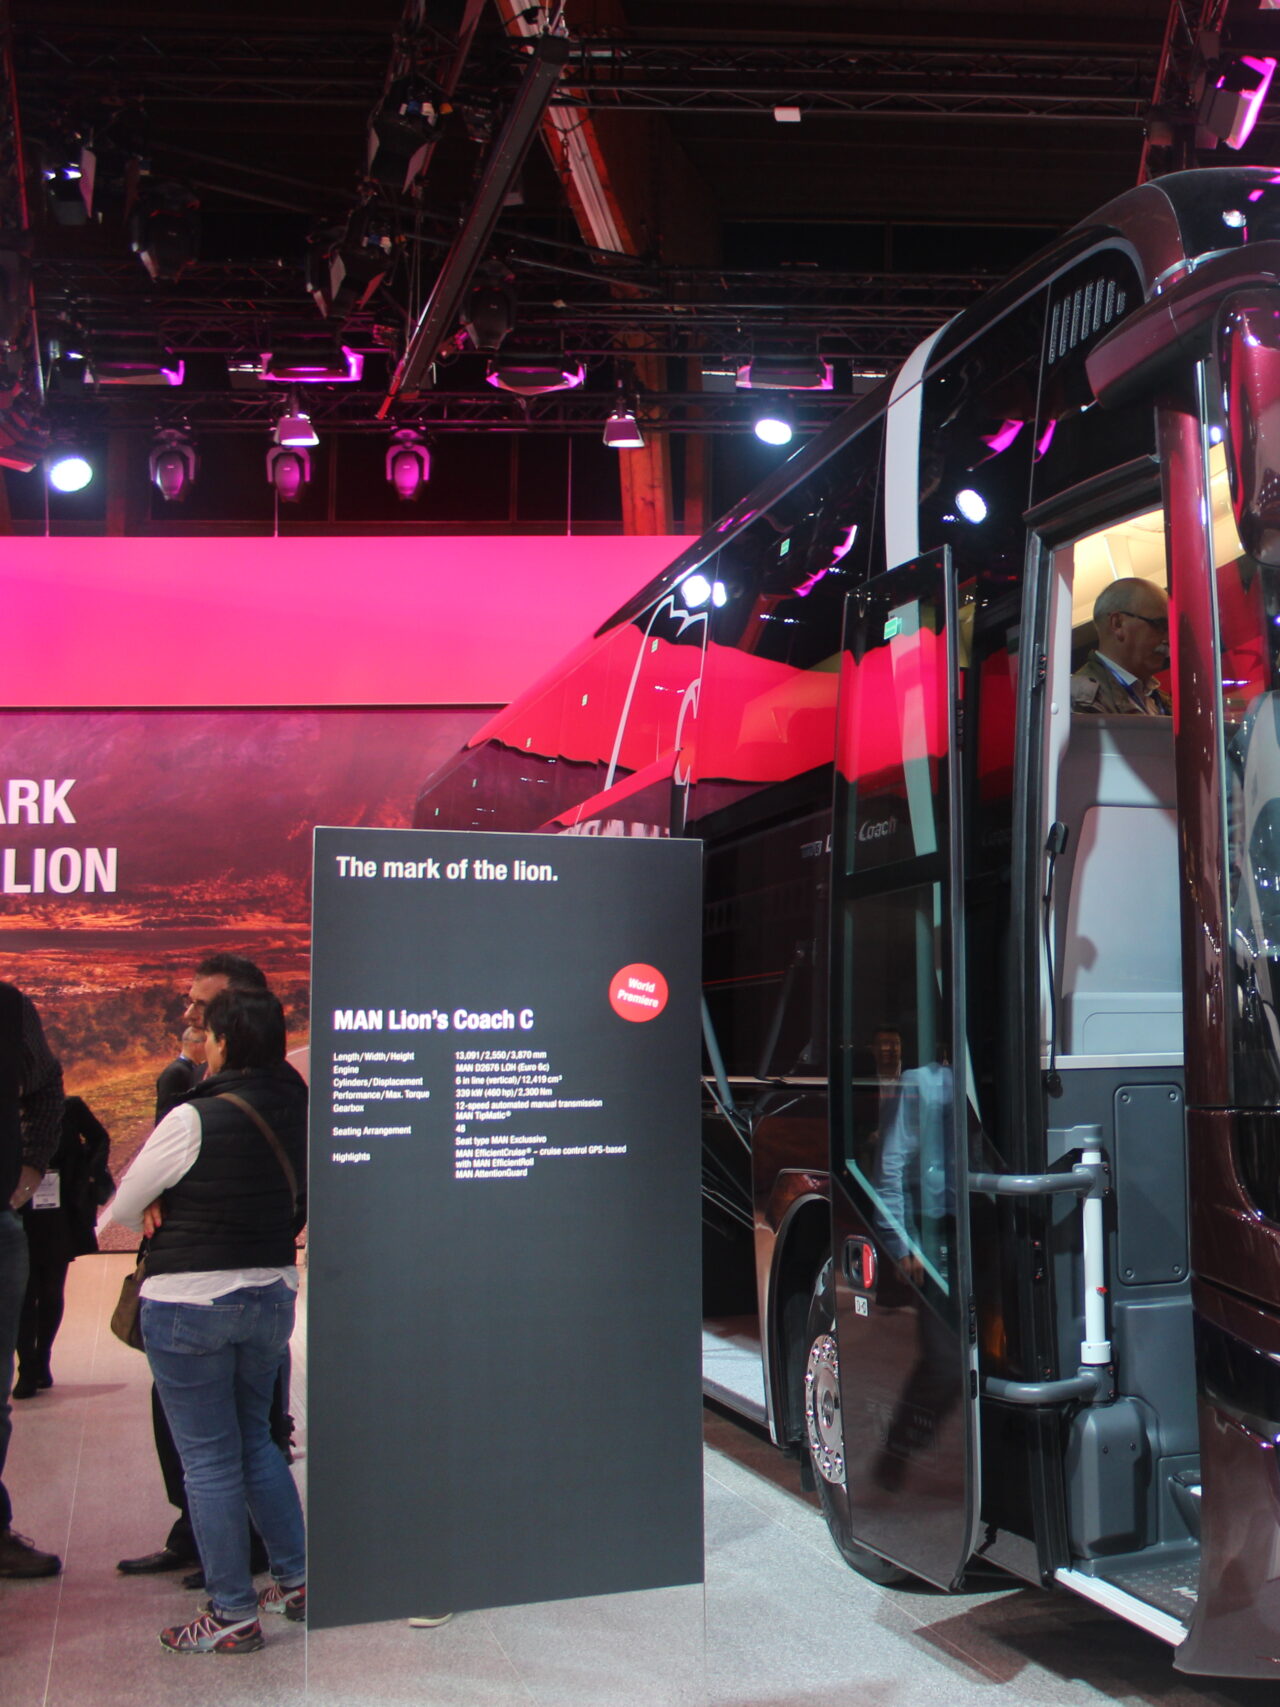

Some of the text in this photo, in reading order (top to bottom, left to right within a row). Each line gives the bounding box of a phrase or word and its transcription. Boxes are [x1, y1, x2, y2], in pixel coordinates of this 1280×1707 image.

[0, 779, 76, 824] RK
[3, 847, 117, 893] LION
[336, 856, 558, 882] The mark of the lion.
[628, 977, 656, 993] World
[617, 988, 659, 1008] Premiere
[334, 1010, 383, 1030] MAN
[454, 1008, 515, 1029] Coach
[520, 1008, 534, 1029] C
[333, 1065, 360, 1076] Engine
[455, 1064, 474, 1072] MAN
[518, 1062, 537, 1072] (Euro
[462, 1076, 470, 1084] in
[471, 1076, 485, 1084] line
[404, 1089, 430, 1100] Torque
[333, 1104, 364, 1112] Gearbox
[456, 1098, 603, 1112] 12-speed automated manual transmission
[455, 1111, 474, 1120] MAN
[333, 1126, 412, 1138] Seating Arrangement
[455, 1136, 473, 1146] Seat
[474, 1136, 490, 1146] type
[490, 1136, 509, 1144] MAN
[455, 1149, 474, 1158] MAN
[540, 1146, 562, 1156] cruise
[562, 1146, 588, 1155] control
[588, 1144, 627, 1155] GPS-based
[333, 1152, 371, 1164] Highlights
[455, 1160, 472, 1168] with
[472, 1158, 491, 1168] MAN
[455, 1168, 528, 1178] MAN AttentionGuard
